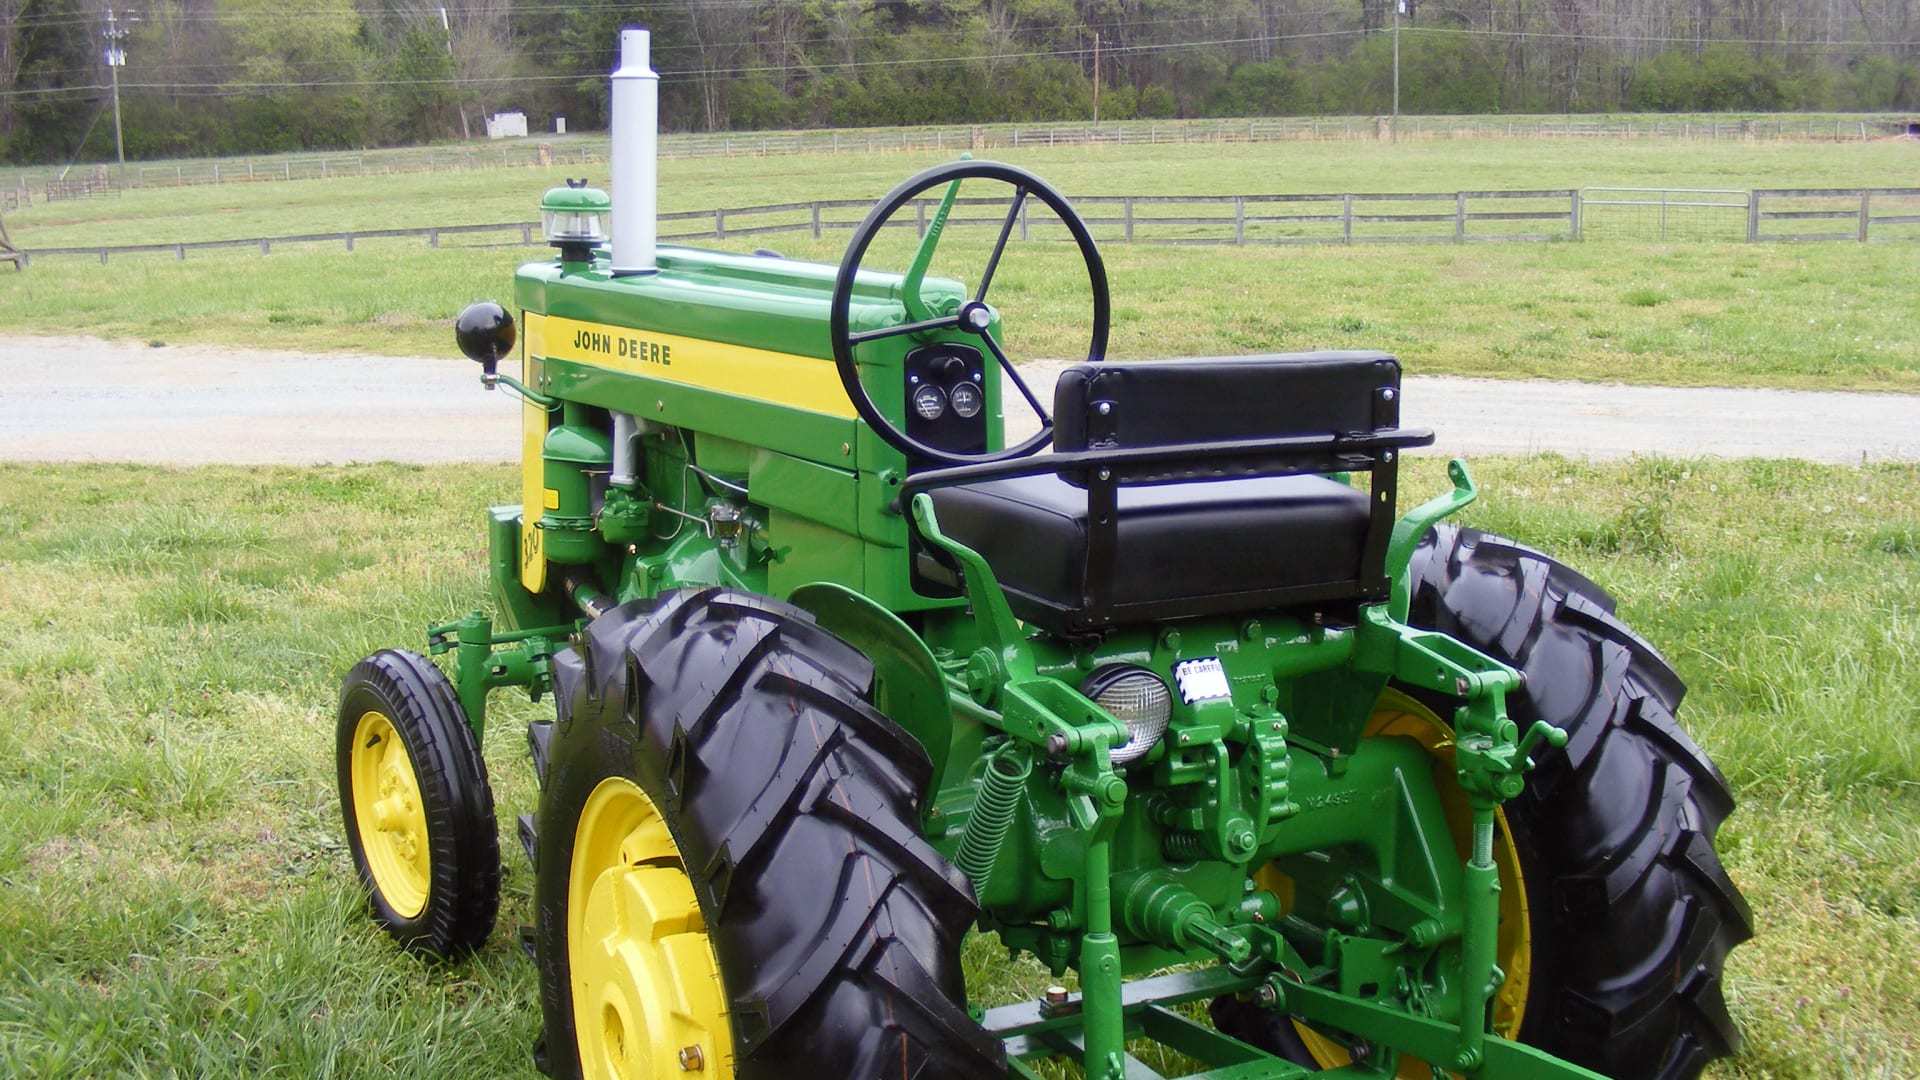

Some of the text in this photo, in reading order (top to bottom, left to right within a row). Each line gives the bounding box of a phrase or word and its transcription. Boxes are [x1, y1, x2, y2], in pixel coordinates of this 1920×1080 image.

[574, 330, 671, 366] JOHN DEERE
[1182, 664, 1222, 677] BE CAREFU
